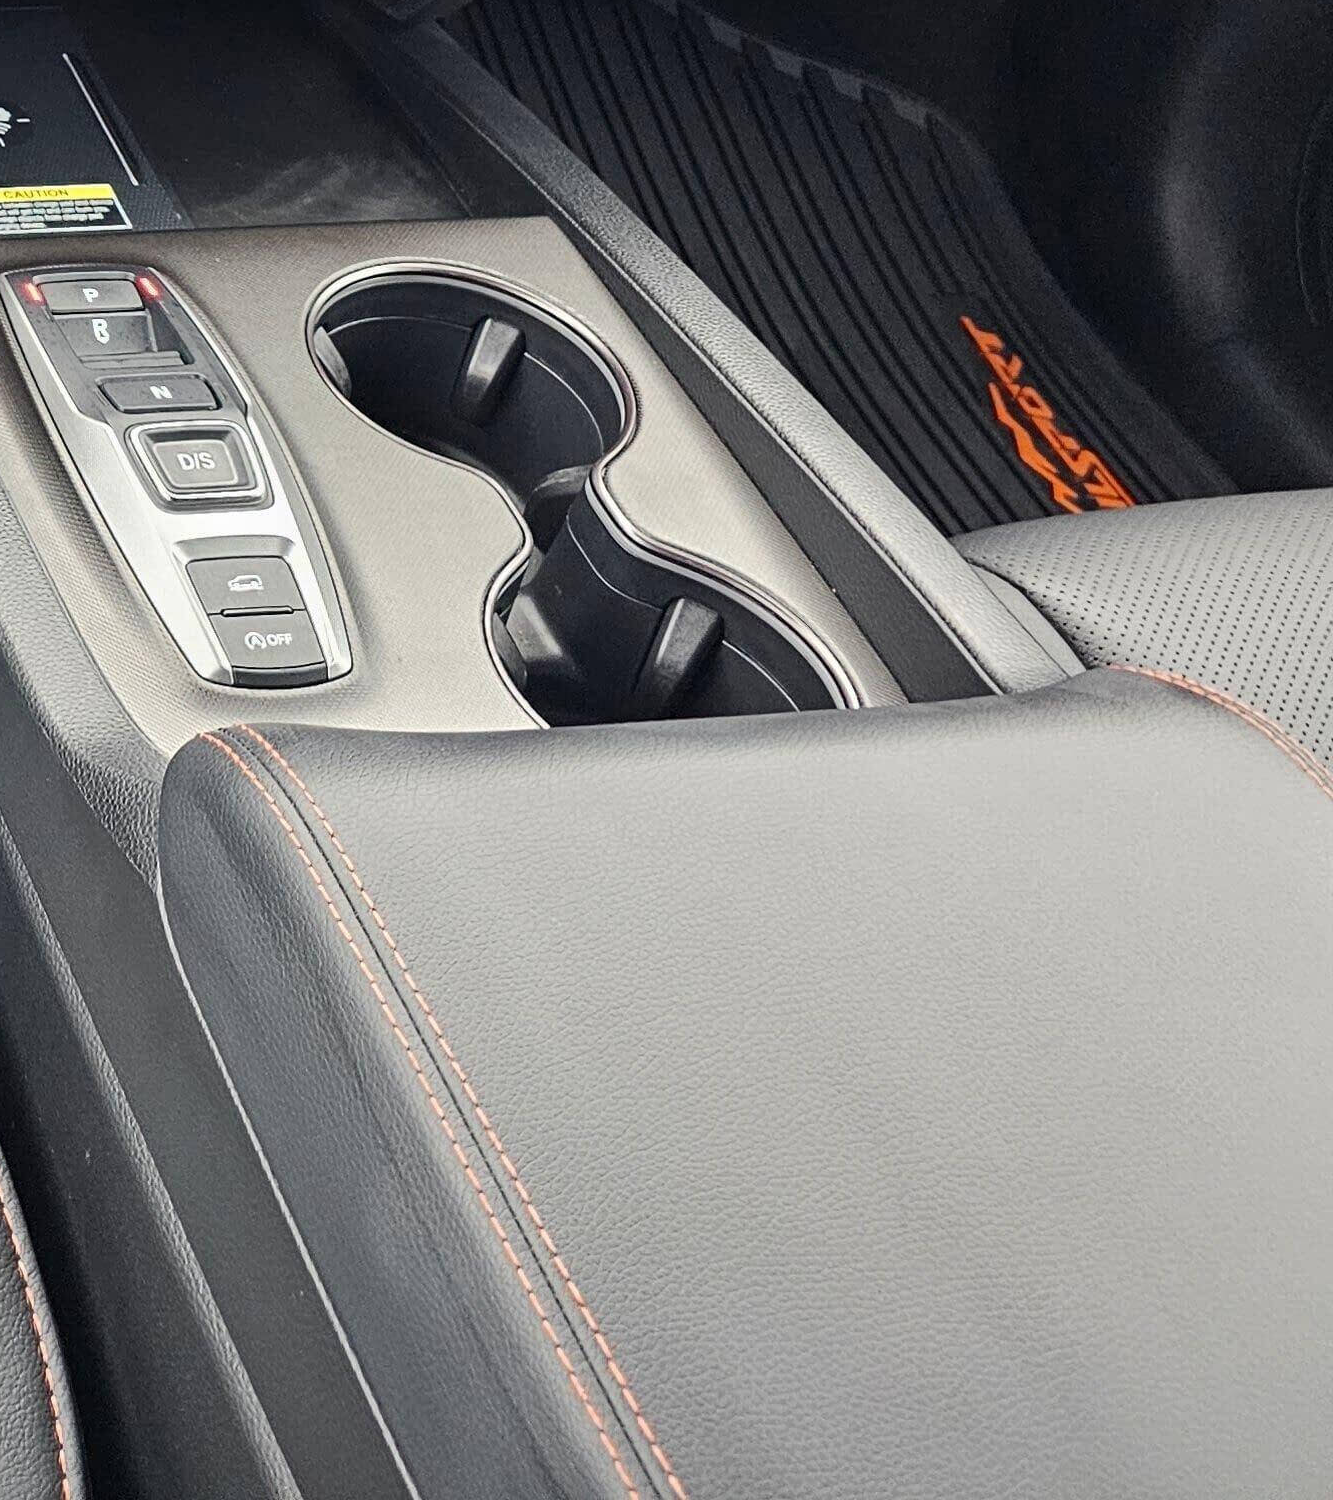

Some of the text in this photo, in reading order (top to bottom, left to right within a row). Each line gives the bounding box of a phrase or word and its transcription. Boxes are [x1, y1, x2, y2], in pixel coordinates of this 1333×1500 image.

[3, 189, 69, 199] CAUTION
[82, 287, 99, 302] P
[149, 385, 173, 399] N
[180, 452, 216, 471] D/S
[266, 631, 293, 646] OFF
